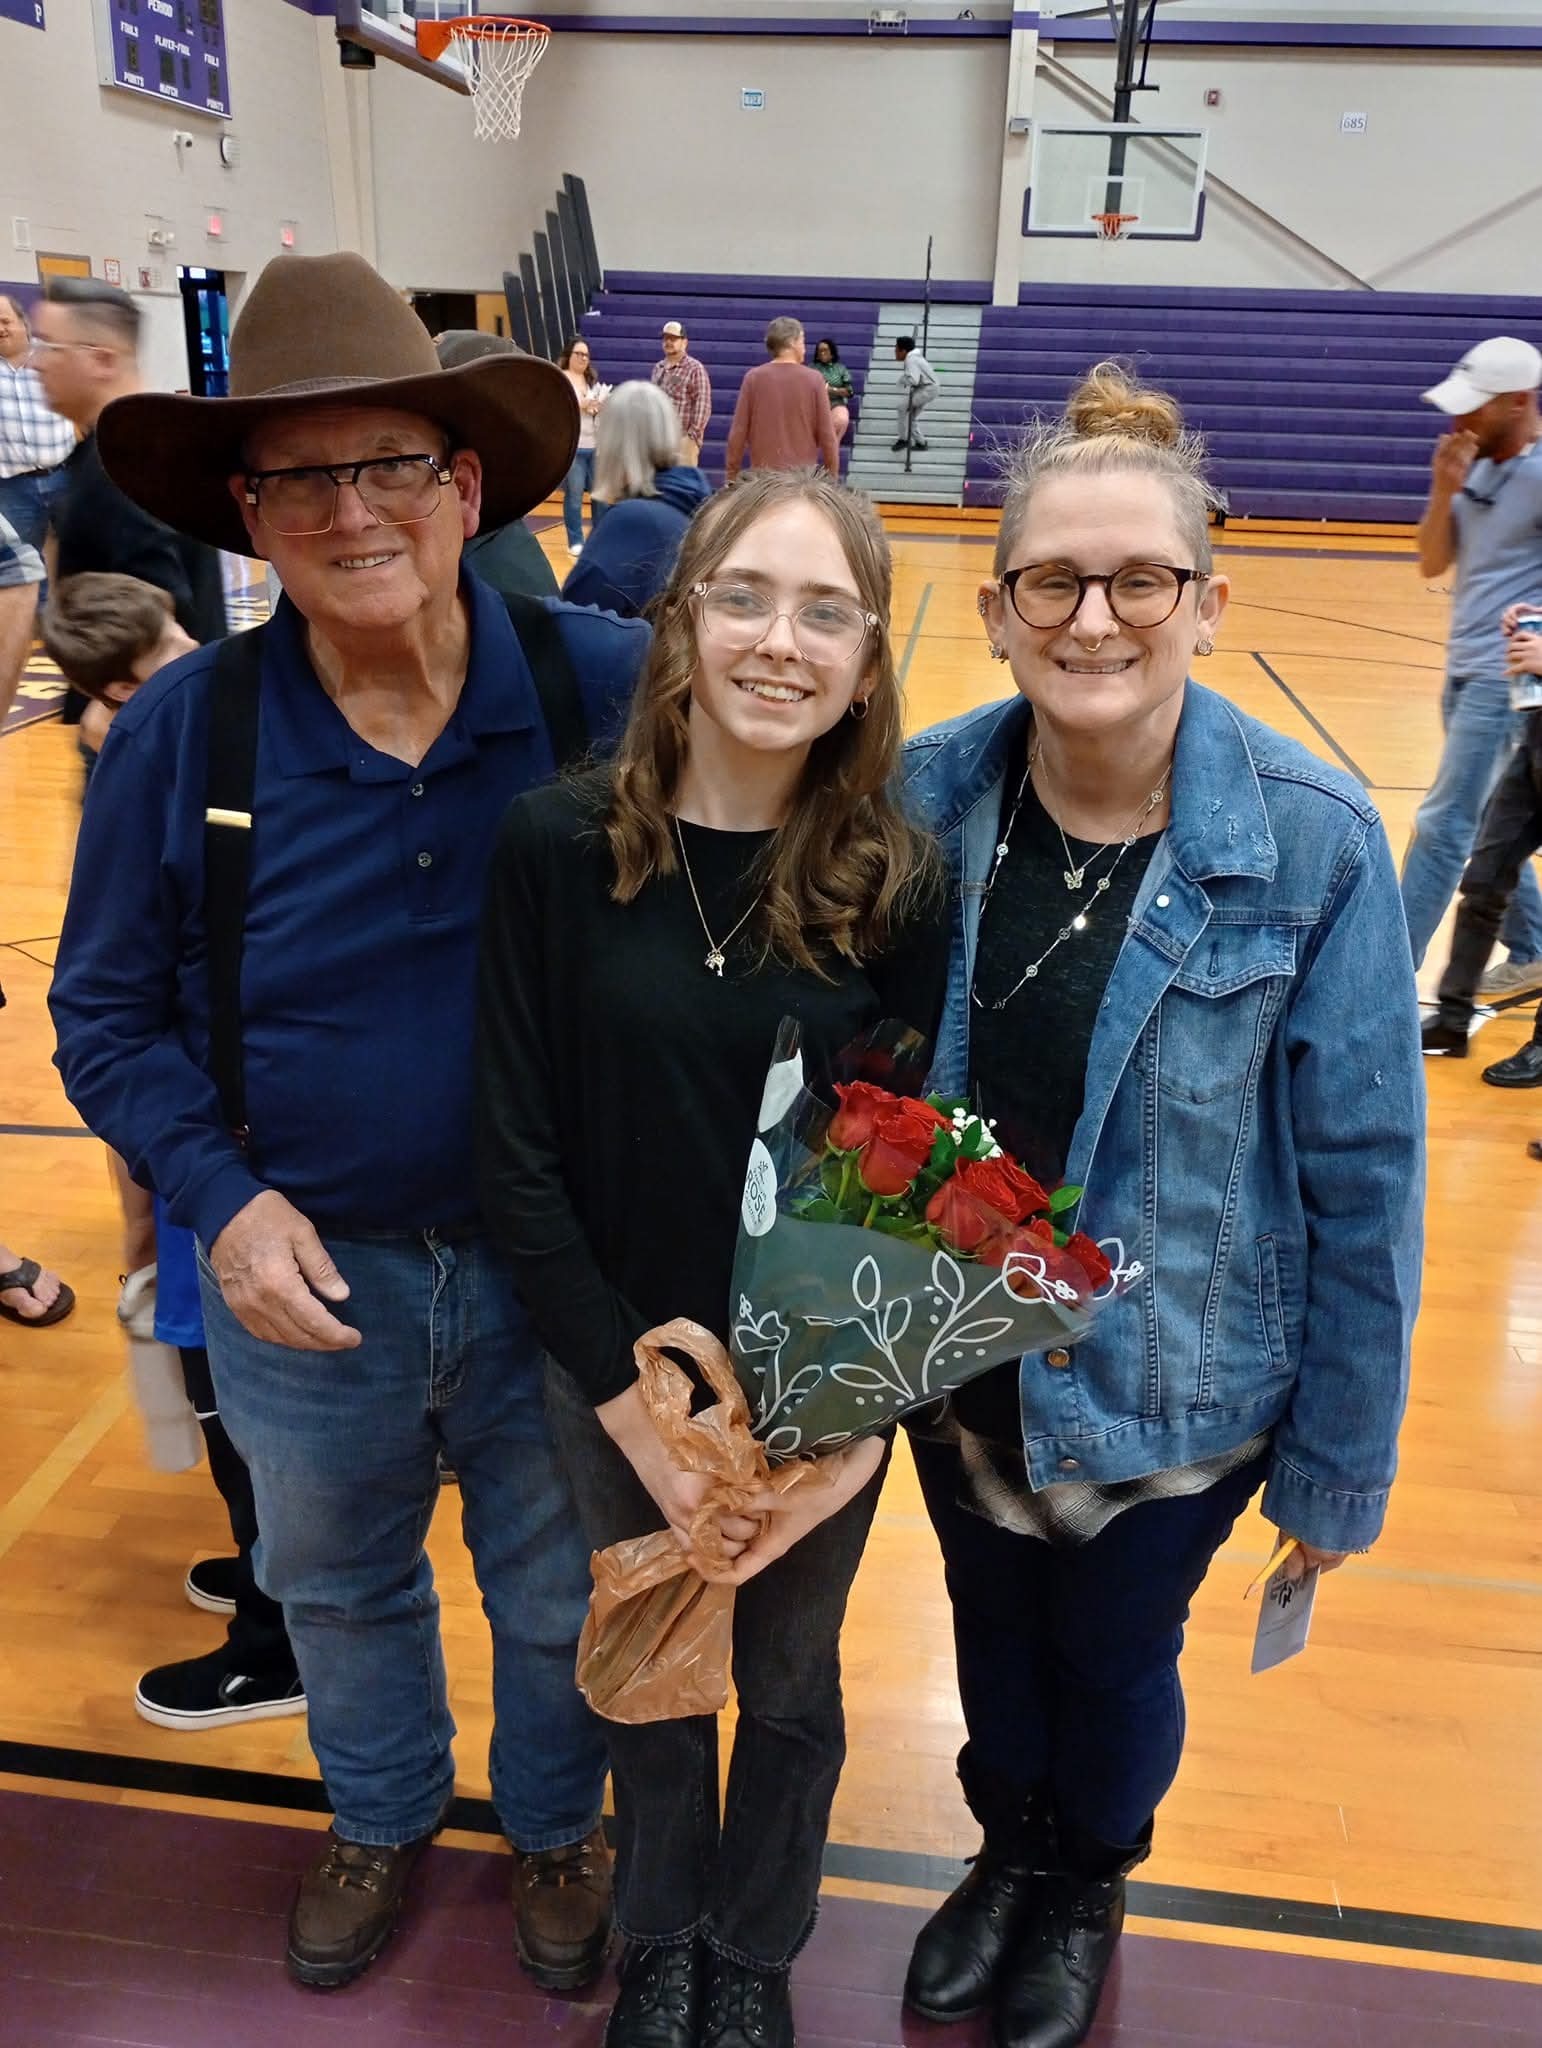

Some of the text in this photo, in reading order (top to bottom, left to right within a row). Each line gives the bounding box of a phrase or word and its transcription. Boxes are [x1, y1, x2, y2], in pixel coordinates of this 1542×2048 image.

[148, 0, 173, 18] PERIOD
[120, 21, 138, 37] FOULS
[155, 34, 191, 56] PLAYER-FOUL
